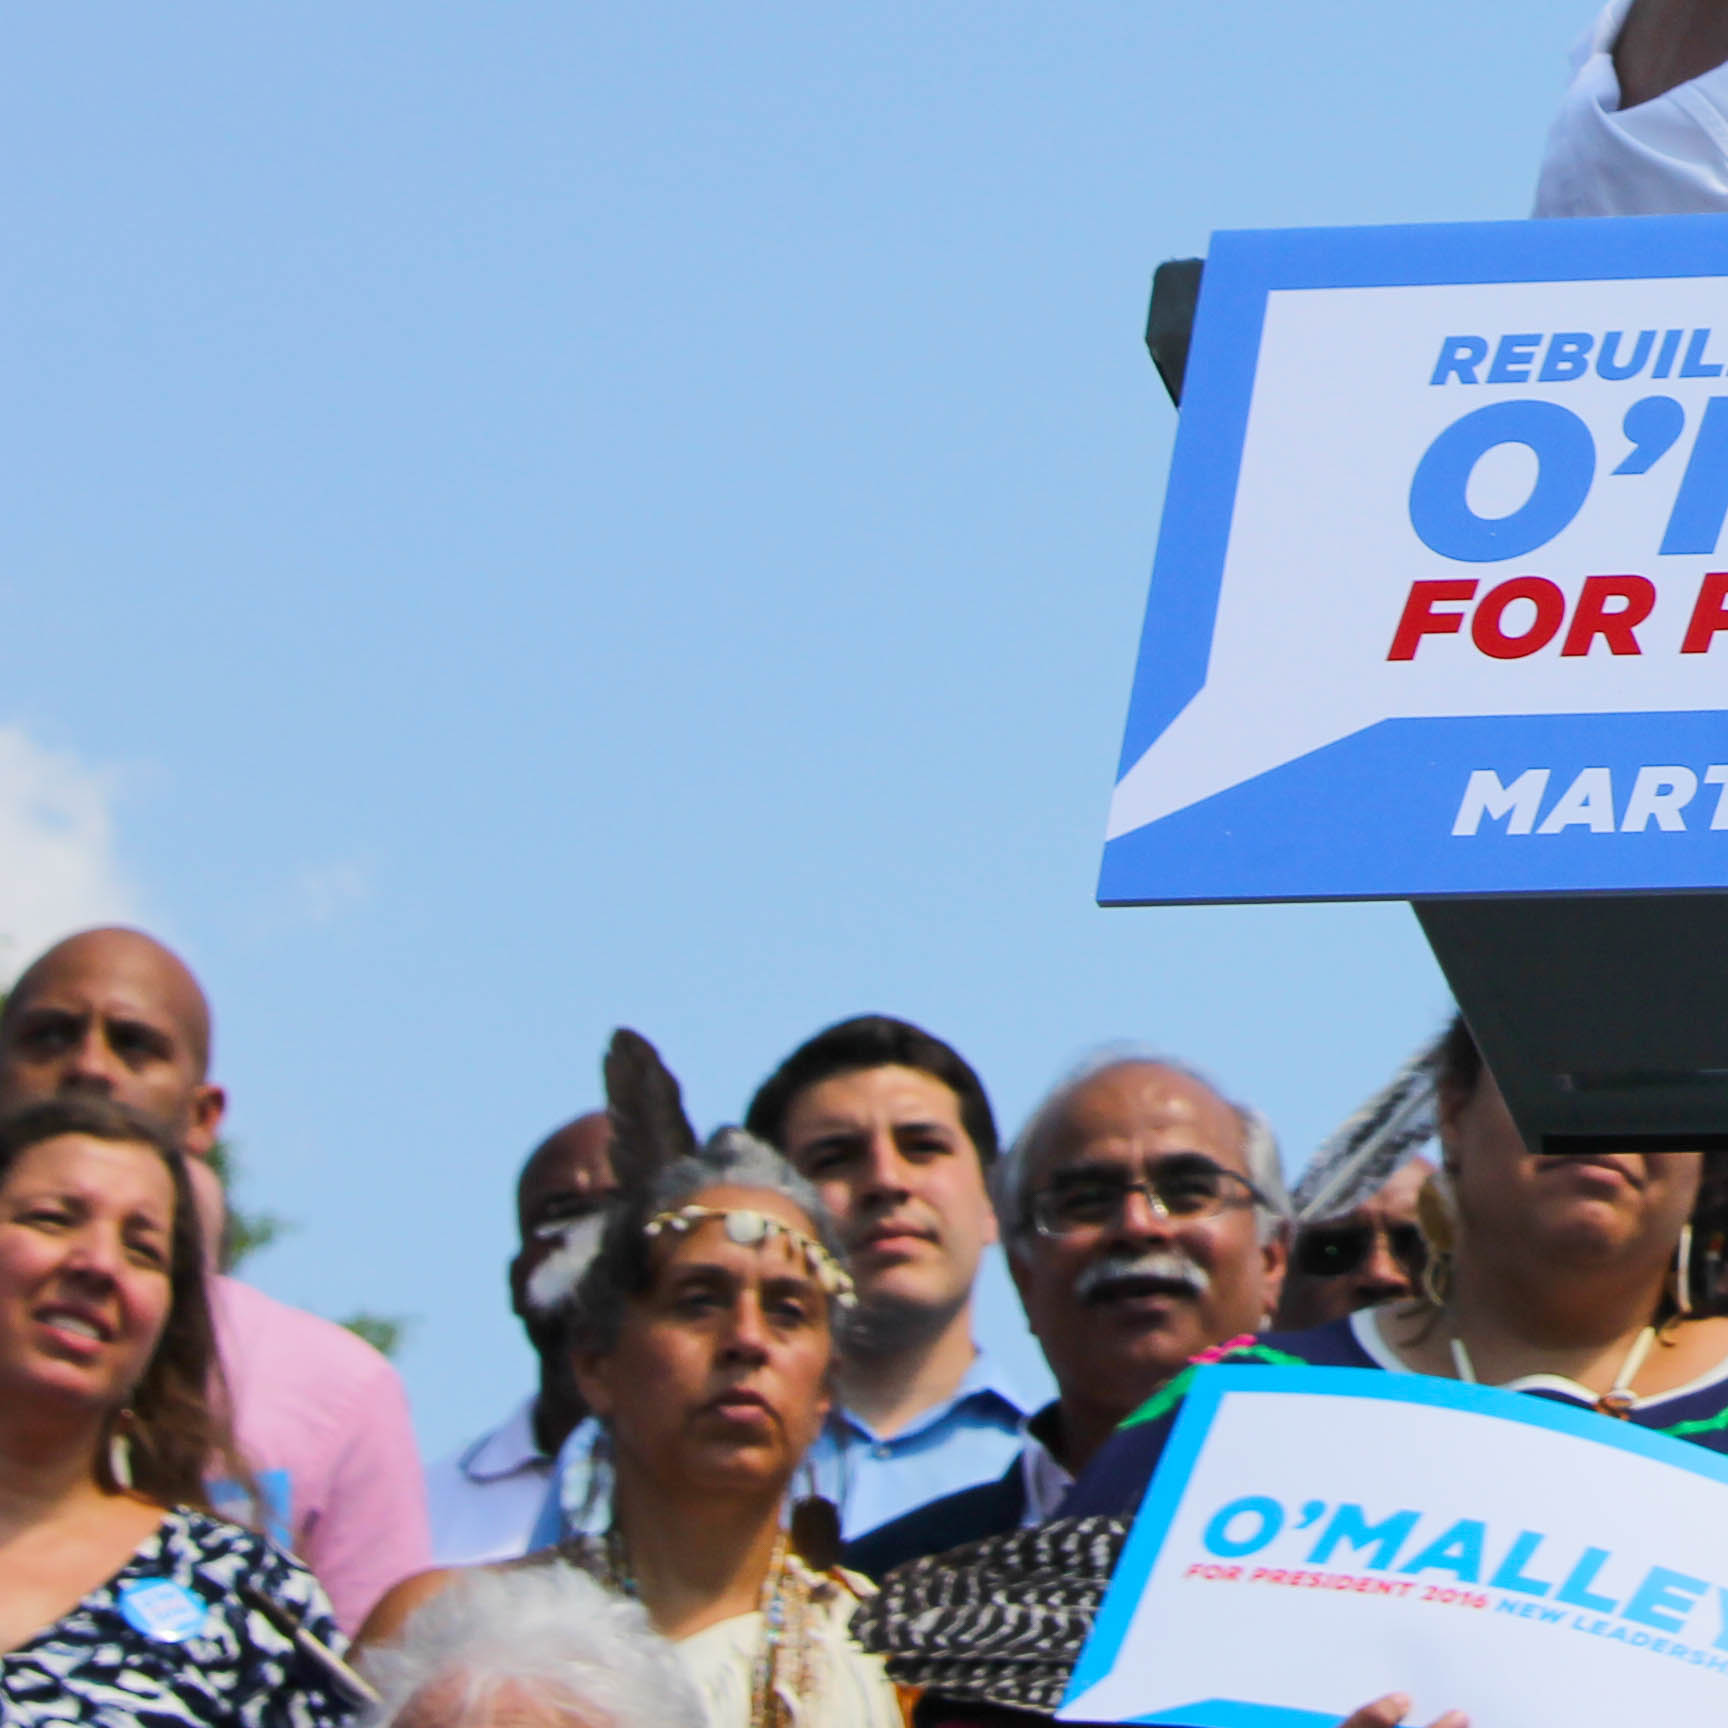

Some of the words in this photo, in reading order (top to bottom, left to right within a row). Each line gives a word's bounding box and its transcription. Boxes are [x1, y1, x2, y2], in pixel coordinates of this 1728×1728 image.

[1386, 576, 1655, 662] FOR
[1183, 1563, 1245, 1582] FOR
[1250, 1567, 1414, 1598] PRESIDENT
[1421, 1585, 1489, 1610] 2016
[1494, 1596, 1570, 1625] NEW
